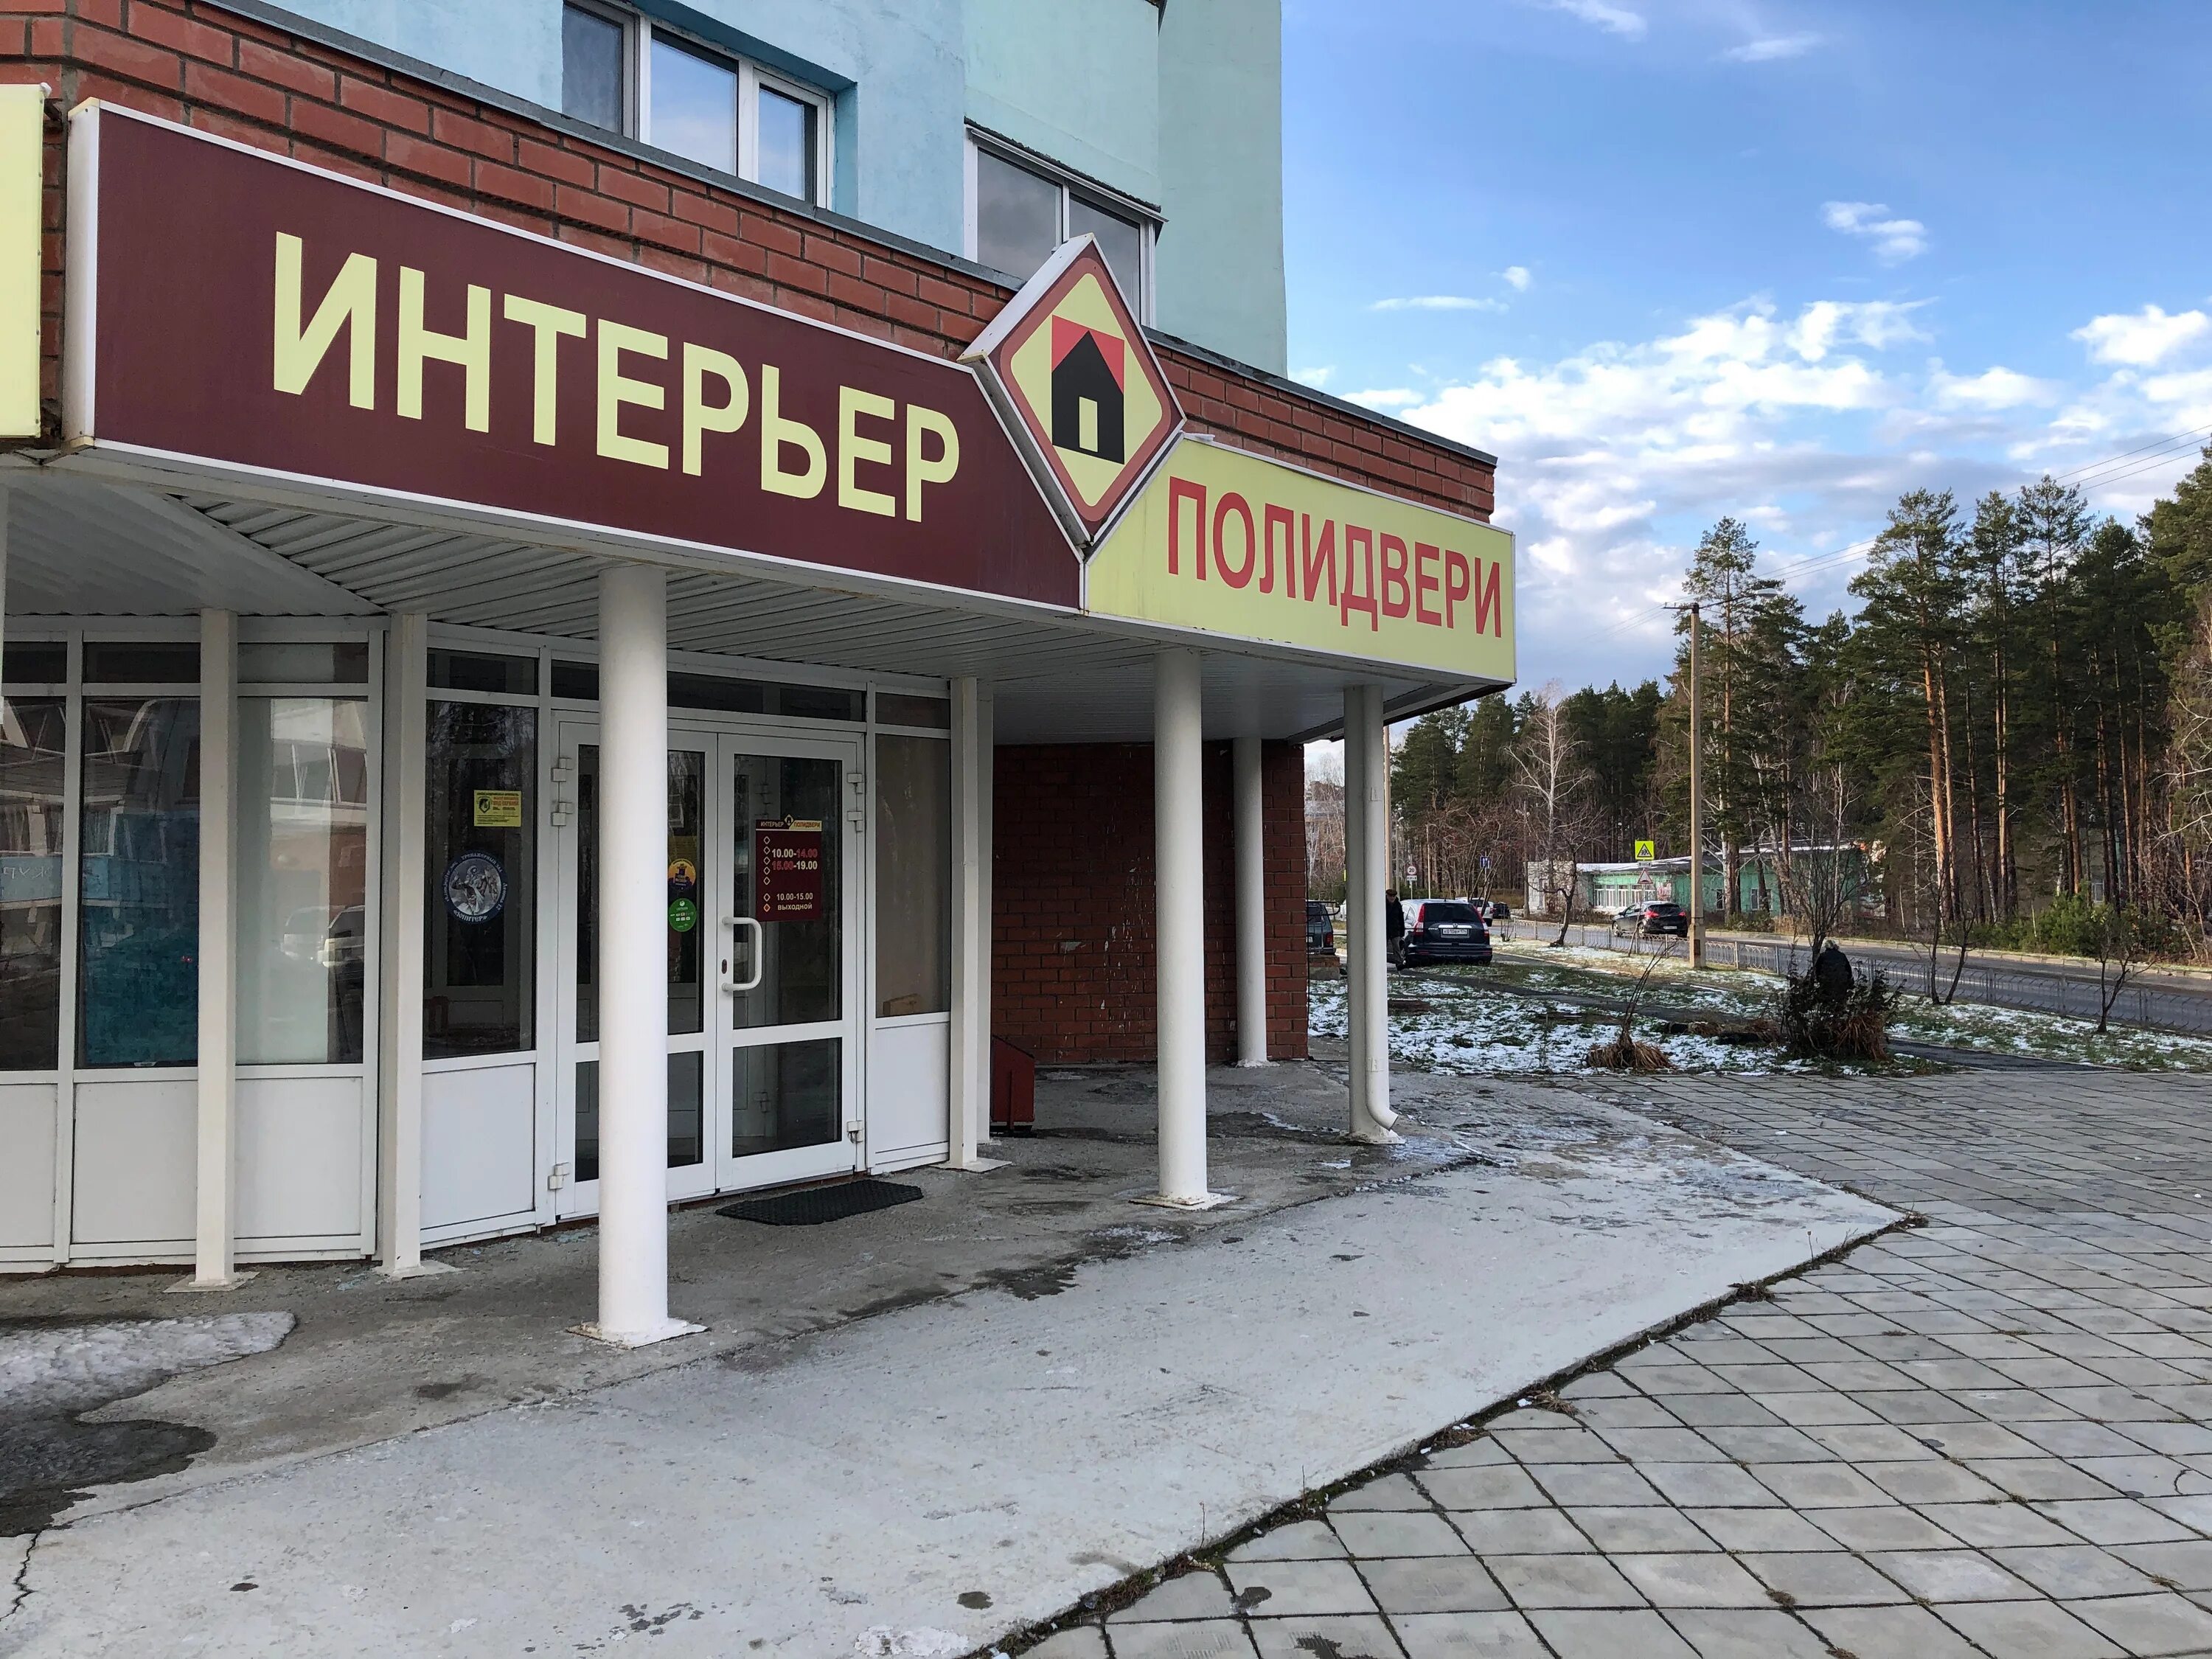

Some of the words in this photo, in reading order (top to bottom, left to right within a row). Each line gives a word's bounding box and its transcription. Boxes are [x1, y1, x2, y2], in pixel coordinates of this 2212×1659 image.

[274, 231, 960, 523] ИНТЕРЬЕР
[1168, 476, 1502, 638] ПОЛИДВЕРИ
[772, 848, 818, 858] 10.00-14.00
[776, 892, 813, 901] 10.00-15.00
[777, 902, 813, 911] выходной
